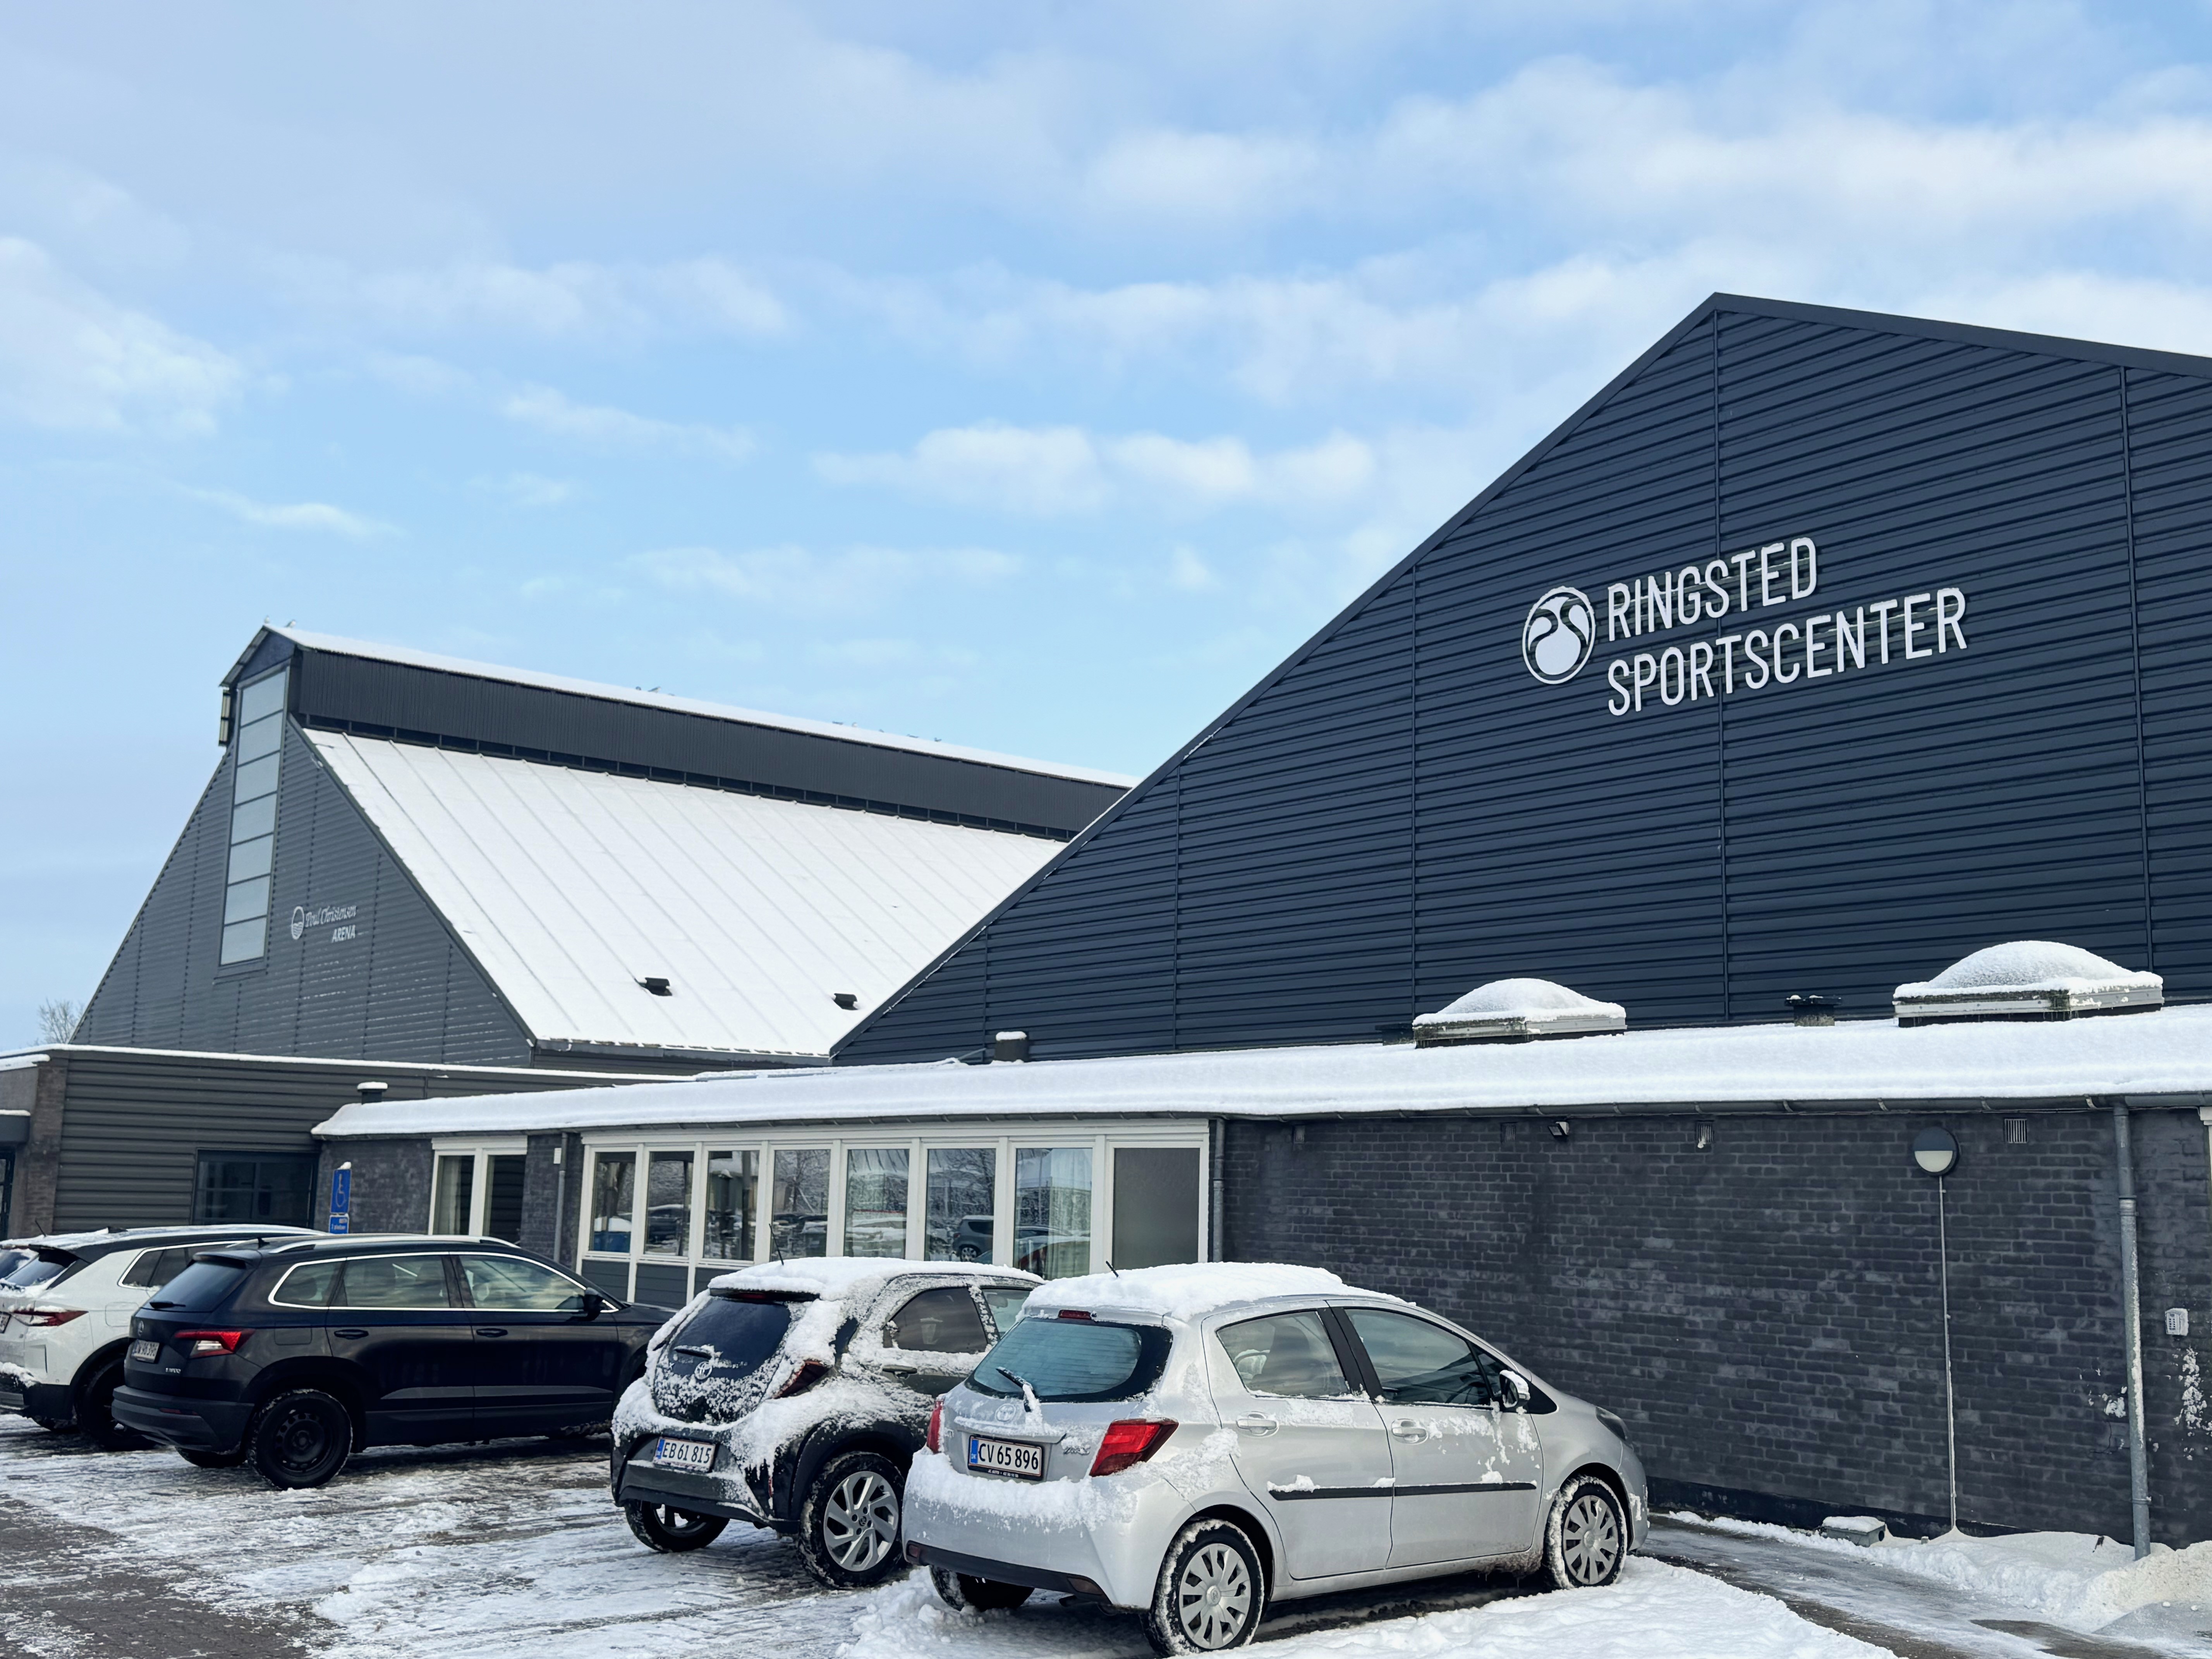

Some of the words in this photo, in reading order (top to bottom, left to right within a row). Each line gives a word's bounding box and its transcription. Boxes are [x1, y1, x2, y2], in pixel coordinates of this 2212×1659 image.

[1607, 537, 1817, 641] RINGSTED
[1607, 587, 1967, 716] SPORTSCENTER
[331, 924, 356, 943] ARENA
[662, 1442, 677, 1458] EB
[677, 1444, 689, 1461] 61
[691, 1446, 712, 1463] 815
[978, 1443, 994, 1463] CV
[997, 1445, 1012, 1466] 65
[1015, 1448, 1039, 1470] 896
